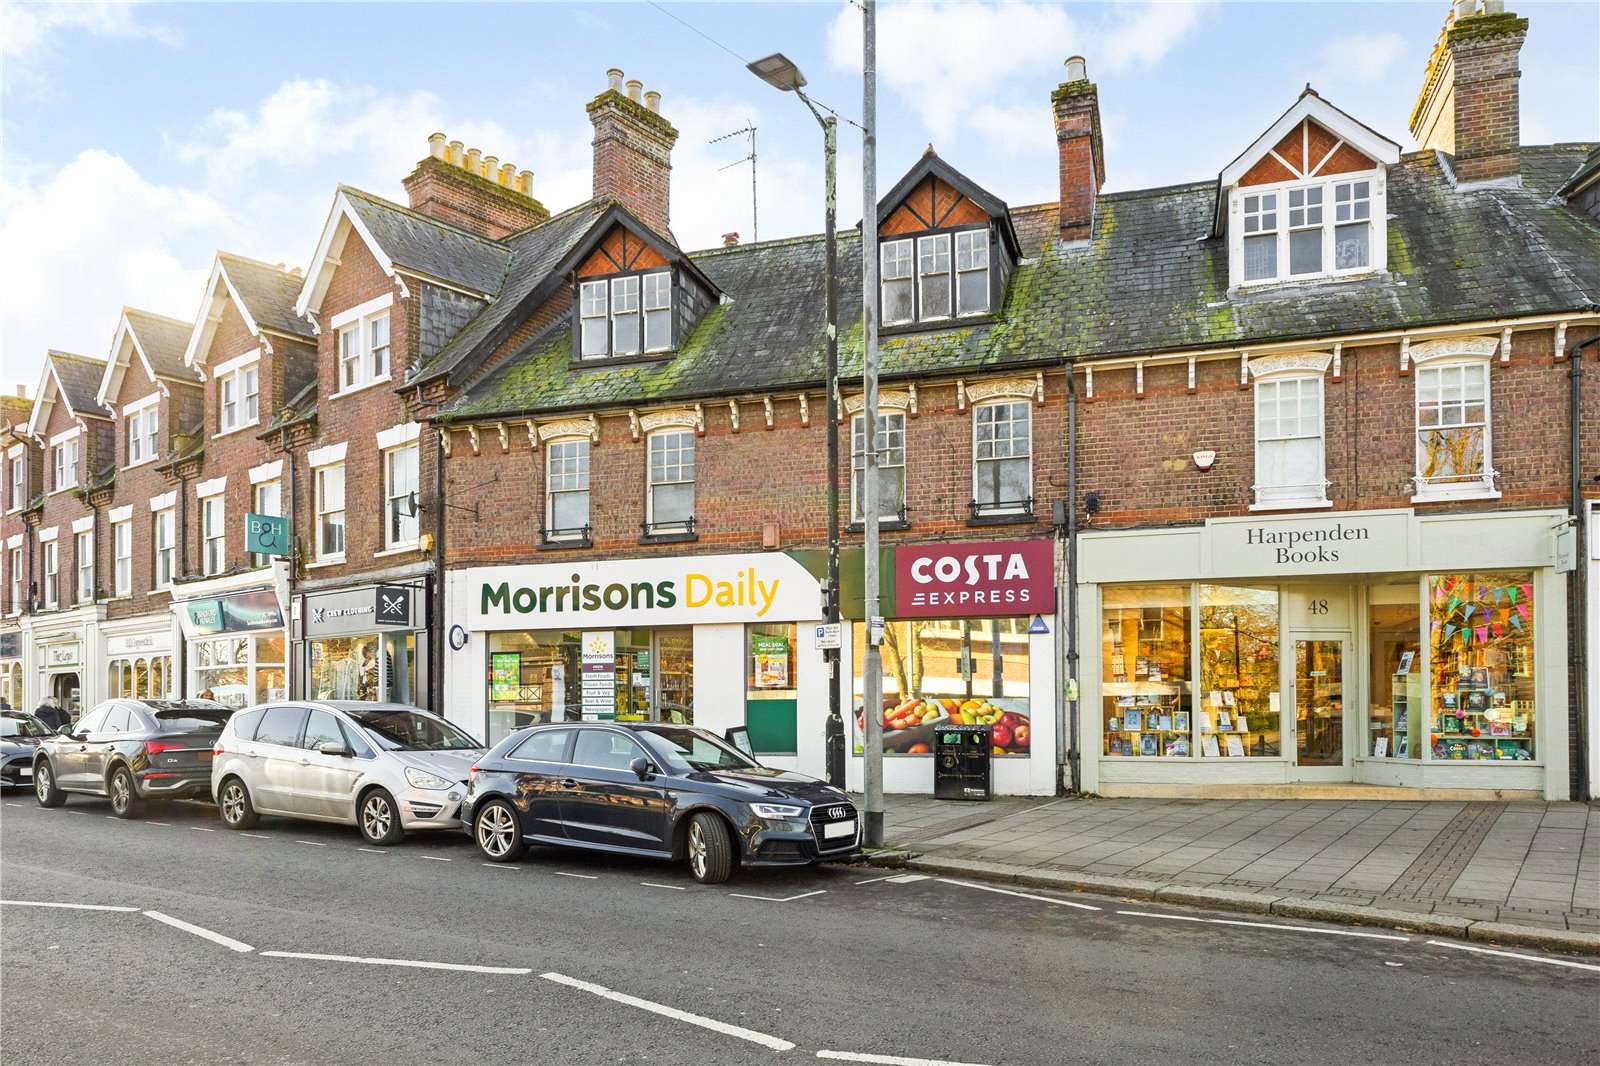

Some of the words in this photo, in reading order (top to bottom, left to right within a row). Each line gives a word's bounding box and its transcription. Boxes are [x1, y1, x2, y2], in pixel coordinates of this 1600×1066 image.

[1247, 524, 1369, 548] Harpenden
[1276, 546, 1339, 564] Books
[911, 553, 1029, 585] COSTA
[481, 573, 676, 615] Morrisons
[686, 568, 779, 617] Daily
[929, 589, 1030, 605] EXPRESS
[1307, 599, 1329, 615] 48
[583, 651, 613, 659] Morrisons
